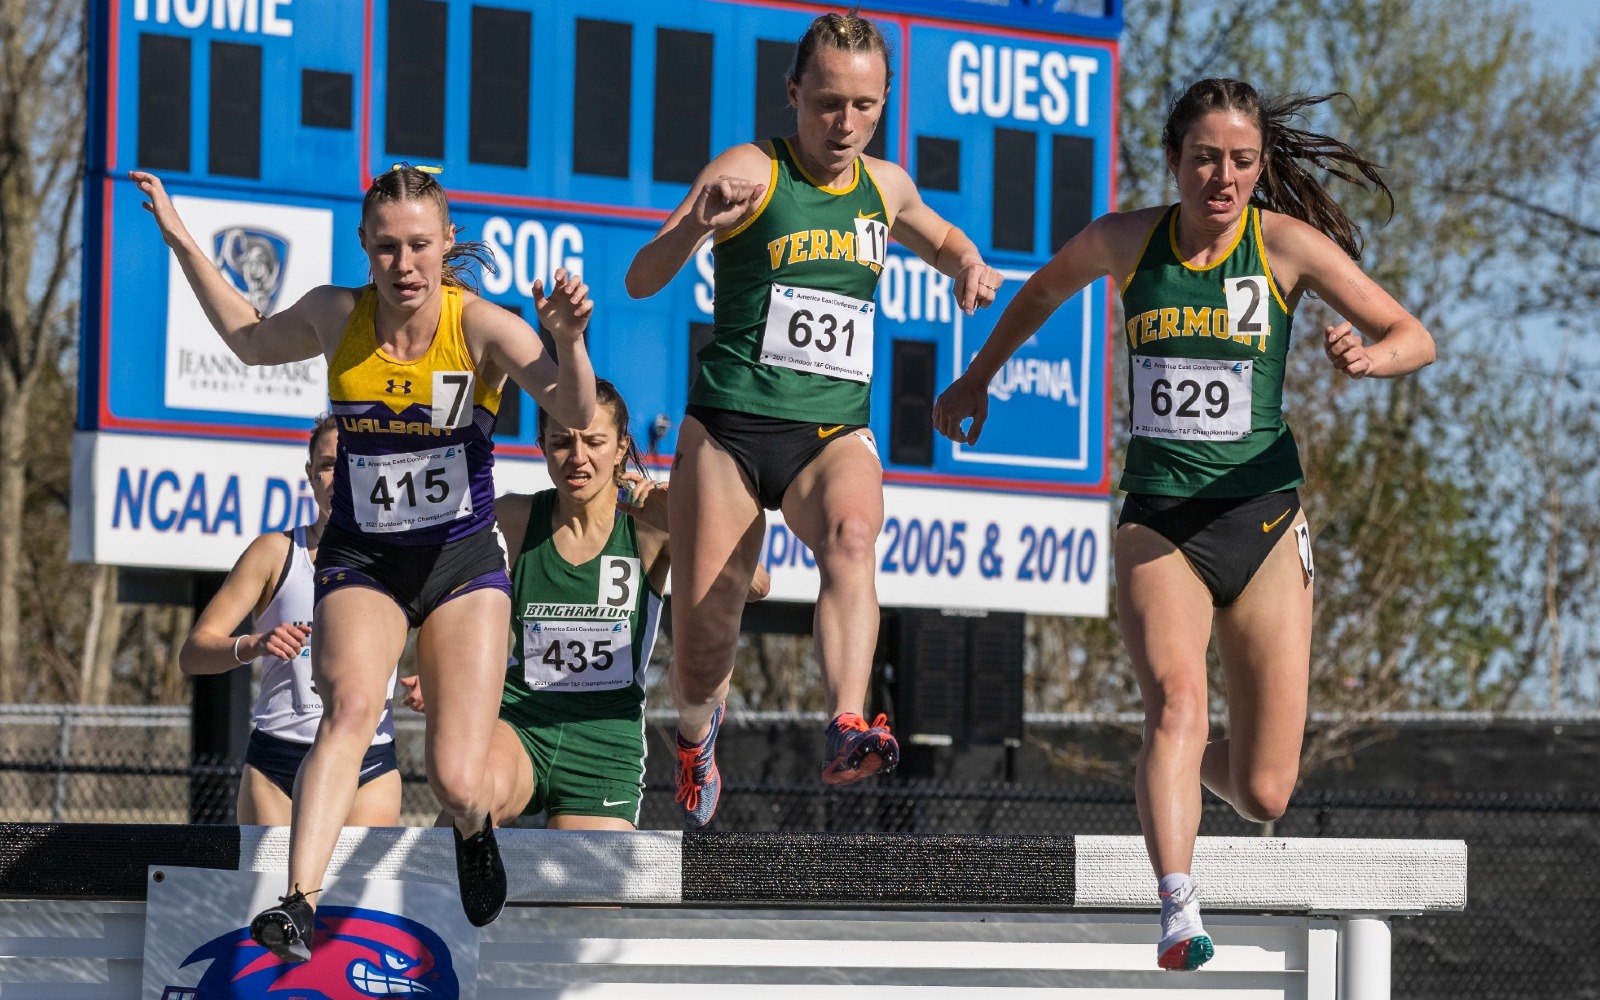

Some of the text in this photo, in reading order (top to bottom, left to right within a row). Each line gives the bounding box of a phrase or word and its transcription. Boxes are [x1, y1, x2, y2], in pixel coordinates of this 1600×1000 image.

[948, 40, 1098, 127] GUEST
[481, 216, 584, 297] SOG
[768, 229, 881, 275] VERM
[865, 221, 885, 265] 11
[796, 293, 820, 302] America
[833, 299, 858, 310] Conference
[879, 253, 952, 324] QTR
[1235, 279, 1262, 333] 2
[788, 309, 854, 357] 631
[1127, 306, 1271, 353] VERMO
[258, 358, 318, 384] DARC
[772, 354, 787, 362] 2021
[789, 356, 813, 367] Outdoor
[824, 363, 864, 376] Championships
[971, 352, 1080, 407] UAFINA
[1153, 362, 1176, 370] America
[442, 374, 469, 427] 7
[1150, 378, 1230, 419] 629
[1154, 426, 1178, 434] Outdoor
[1192, 429, 1239, 437] Championships
[367, 454, 441, 468] America East Conference
[111, 466, 242, 536] NCAA
[369, 467, 450, 512] 415
[403, 518, 416, 526] T&F
[417, 508, 461, 523] Championships
[881, 517, 967, 578] 2005
[979, 522, 1004, 579] &
[1016, 524, 1097, 585] 2010
[606, 559, 632, 607] 3
[542, 639, 614, 673] 435
[582, 679, 623, 687] Championships
